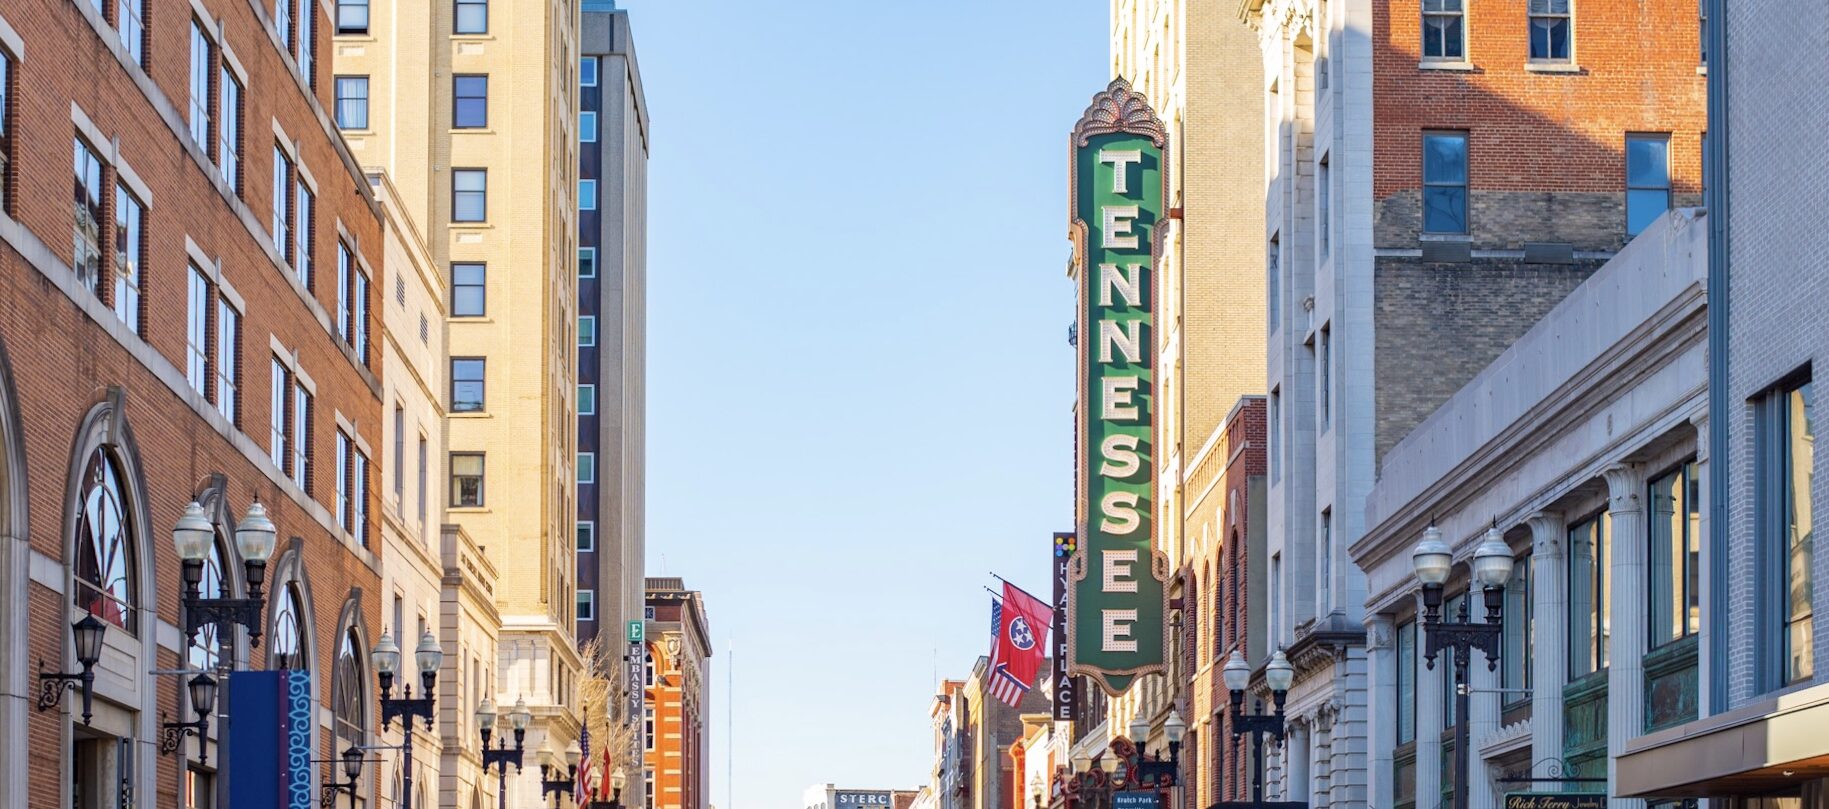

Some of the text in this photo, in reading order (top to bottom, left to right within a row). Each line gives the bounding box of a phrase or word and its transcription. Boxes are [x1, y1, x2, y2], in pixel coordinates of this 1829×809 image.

[1099, 149, 1141, 652] TENNESSEE
[630, 647, 641, 766] EMBASSY SUITES
[1059, 643, 1072, 719] PLACE
[840, 794, 887, 804] STERC
[1508, 796, 1536, 809] Rick
[1538, 796, 1570, 809] Terry
